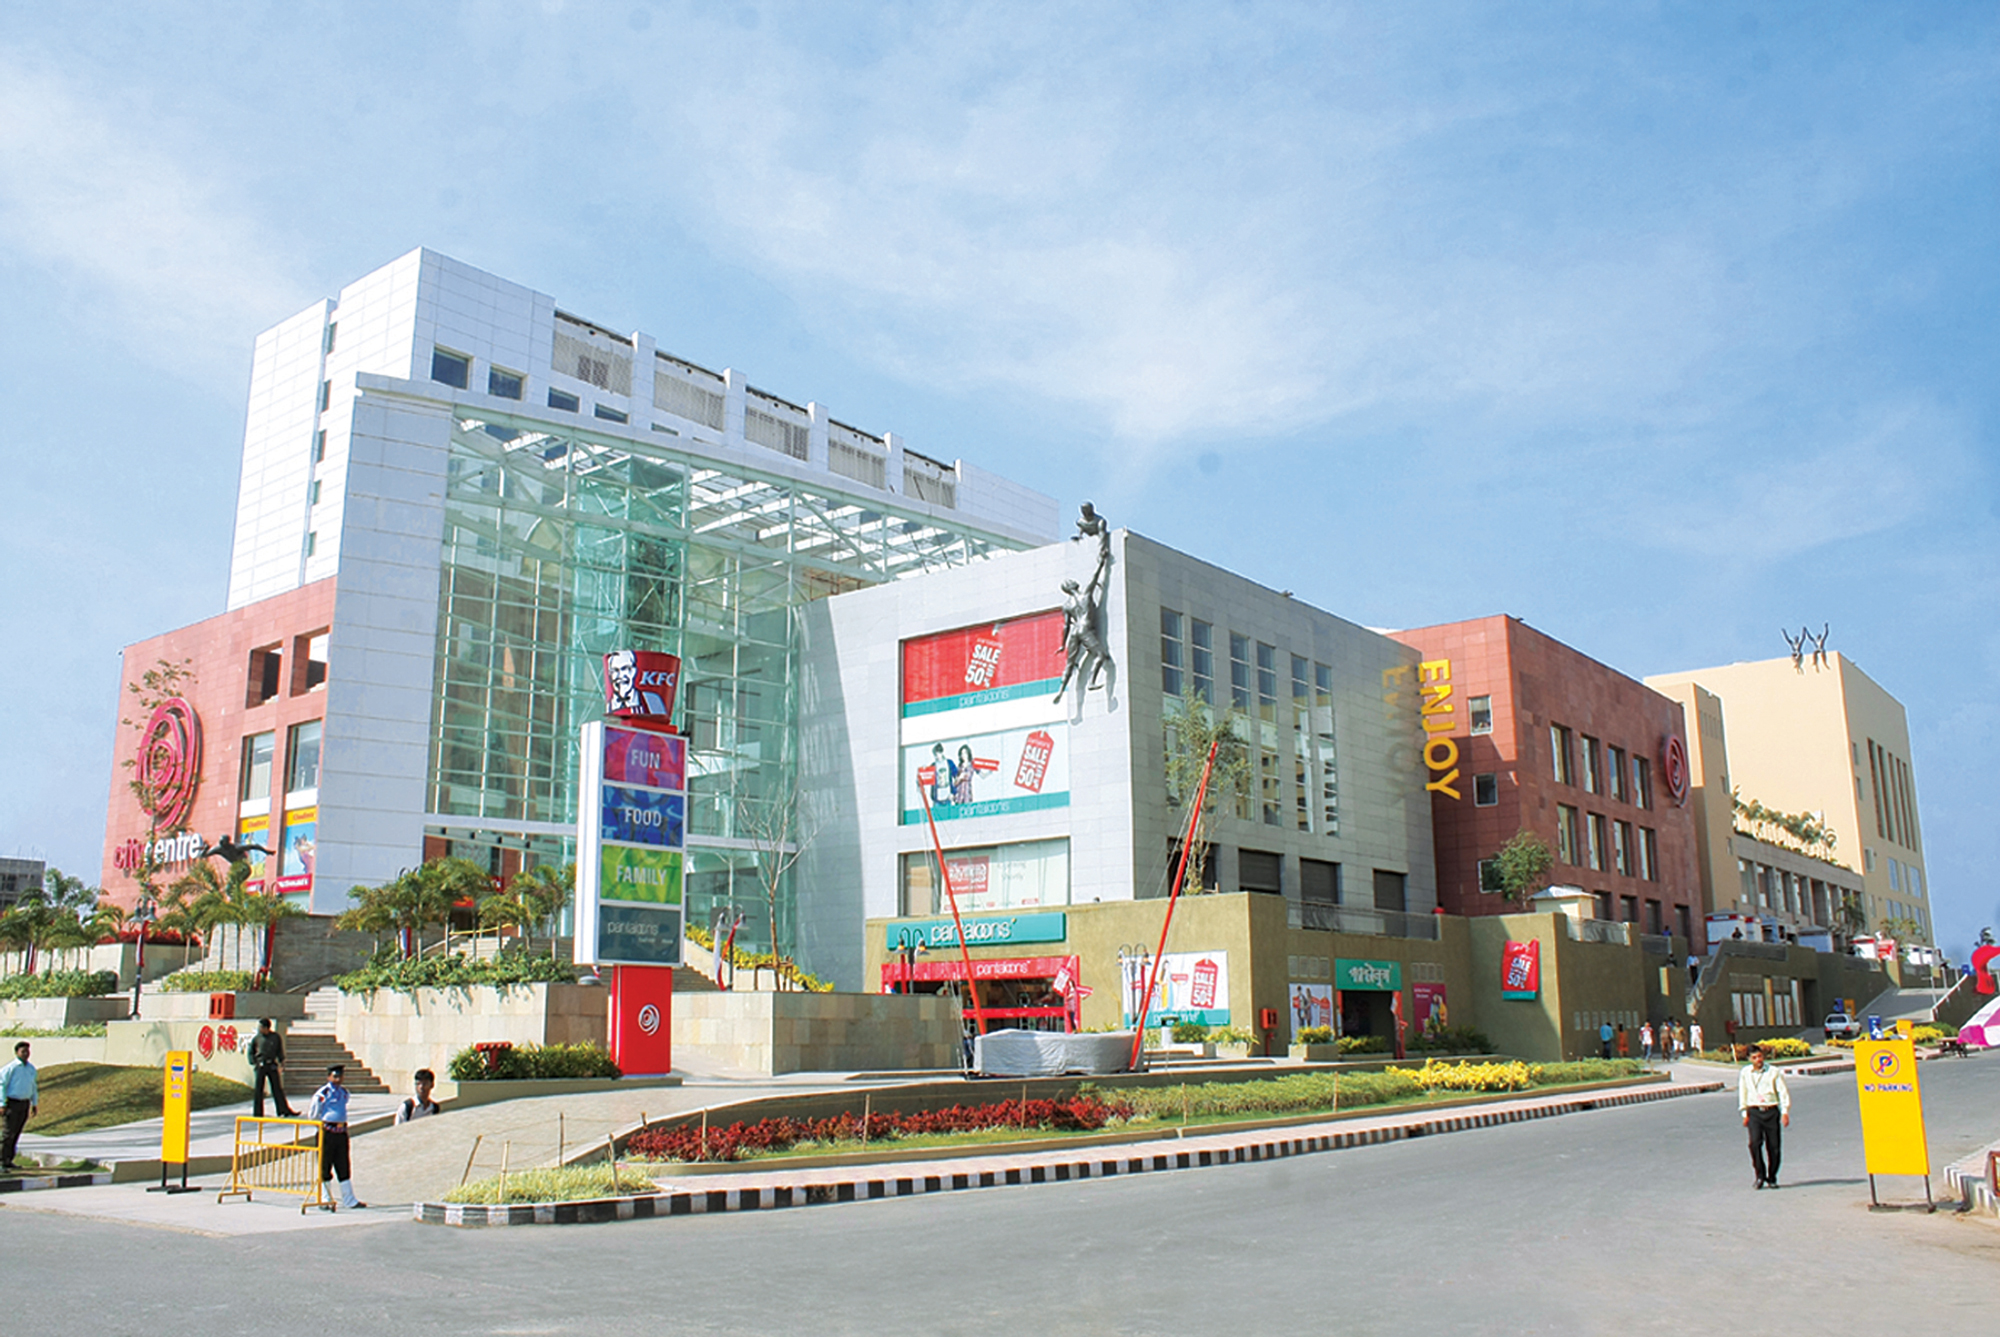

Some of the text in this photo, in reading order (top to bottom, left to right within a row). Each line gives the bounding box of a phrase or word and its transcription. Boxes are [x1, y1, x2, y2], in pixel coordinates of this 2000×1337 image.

[973, 644, 1001, 664] SALE
[640, 670, 676, 687] KFC
[1418, 658, 1460, 800] ENJOY
[631, 748, 661, 769] FUN
[1024, 744, 1049, 765] SALE
[624, 806, 663, 827] FOOD
[616, 865, 667, 886] FAMILY
[931, 919, 1012, 946] panaloons
[1864, 1082, 1876, 1092] NO
